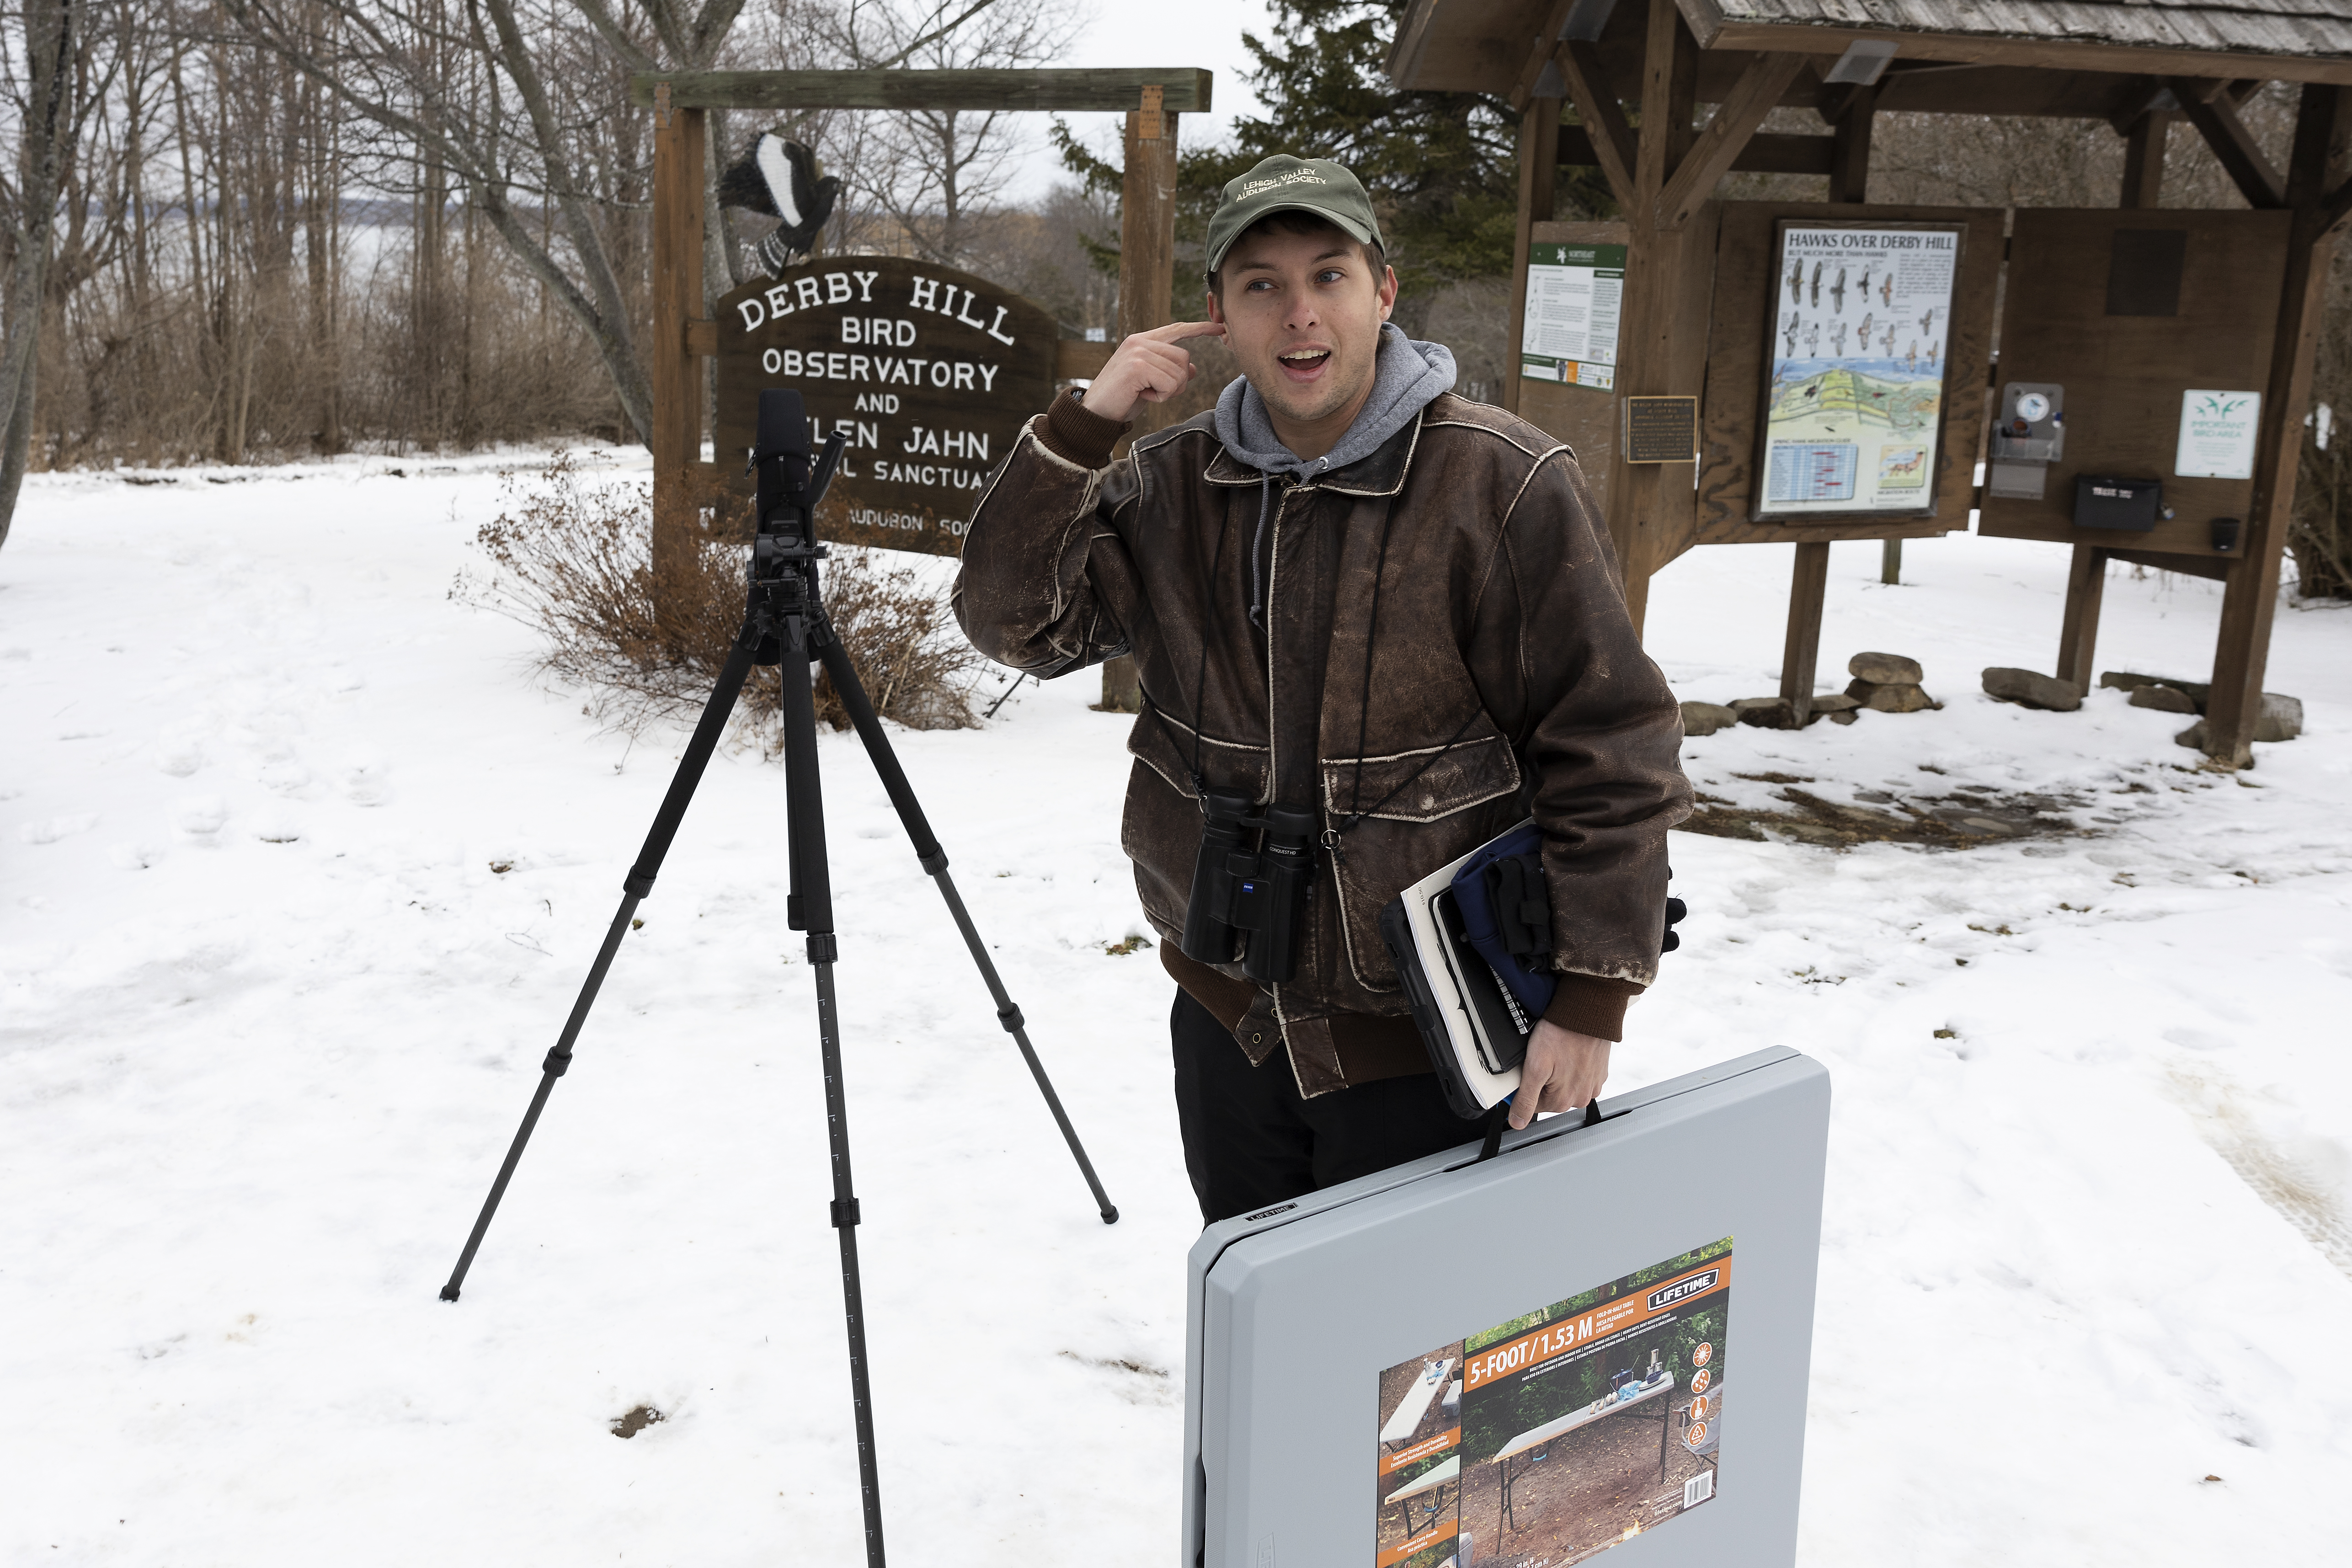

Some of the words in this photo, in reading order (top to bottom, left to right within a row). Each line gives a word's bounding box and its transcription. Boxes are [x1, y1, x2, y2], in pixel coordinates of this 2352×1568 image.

[1236, 182, 1281, 203] AUDUBON
[1286, 176, 1327, 185] SOCIETY
[1243, 179, 1276, 190] LEHIGH
[1280, 168, 1317, 181] VALLEY
[1789, 234, 1838, 248] HAWKS
[1842, 235, 1877, 248] OVER
[1881, 235, 1921, 249] DERBY
[1925, 237, 1953, 250] HILL
[737, 271, 878, 332] DERBY
[909, 276, 1015, 347] HILL
[841, 316, 917, 347] BIRD
[763, 348, 999, 392] OBSERVATORY
[854, 393, 900, 415] AND
[806, 416, 878, 450] LEN
[903, 426, 989, 461] JAHN
[2217, 430, 2242, 438] AREA
[874, 460, 991, 490] SANCTUA
[1250, 1205, 1291, 1221] LIFETIME
[1655, 1275, 1711, 1306] LIFETIME
[1596, 1304, 1622, 1319] FOLD-IN-HALF
[1622, 1300, 1634, 1309] TABLE
[1596, 1318, 1607, 1328] MESA
[1607, 1311, 1626, 1323] PLEGABLE
[1601, 1323, 1614, 1332] MITAD
[1470, 1341, 1529, 1384] 5-FOOT
[1529, 1337, 1539, 1361] /
[1541, 1325, 1574, 1355] 1.53
[1578, 1316, 1593, 1341] M
[1557, 1357, 1574, 1367] INTERIORES
[1577, 1351, 1588, 1360] ESTABLE
[1589, 1346, 1601, 1355] POSTURA
[1638, 1324, 1656, 1334] RESISTENTES
[1658, 1315, 1677, 1326] ABOLLADURAS
[1544, 1358, 1558, 1367] OUTDOOR
[1564, 1350, 1575, 1359] INDOOR
[1391, 1458, 1408, 1468] Excelente
[1407, 1450, 1426, 1461] Resistencia
[1429, 1439, 1449, 1452] Durabilidad
[1392, 1451, 1408, 1461] Superior
[1408, 1444, 1423, 1455] Strength
[1430, 1435, 1447, 1445] Durability
[1654, 1500, 1682, 1516] lifetime.com
[1397, 1539, 1417, 1552] Convenient
[1426, 1530, 1438, 1539] Handle
[1414, 1541, 1428, 1551] práctica
[1543, 1557, 1549, 1565] H)
